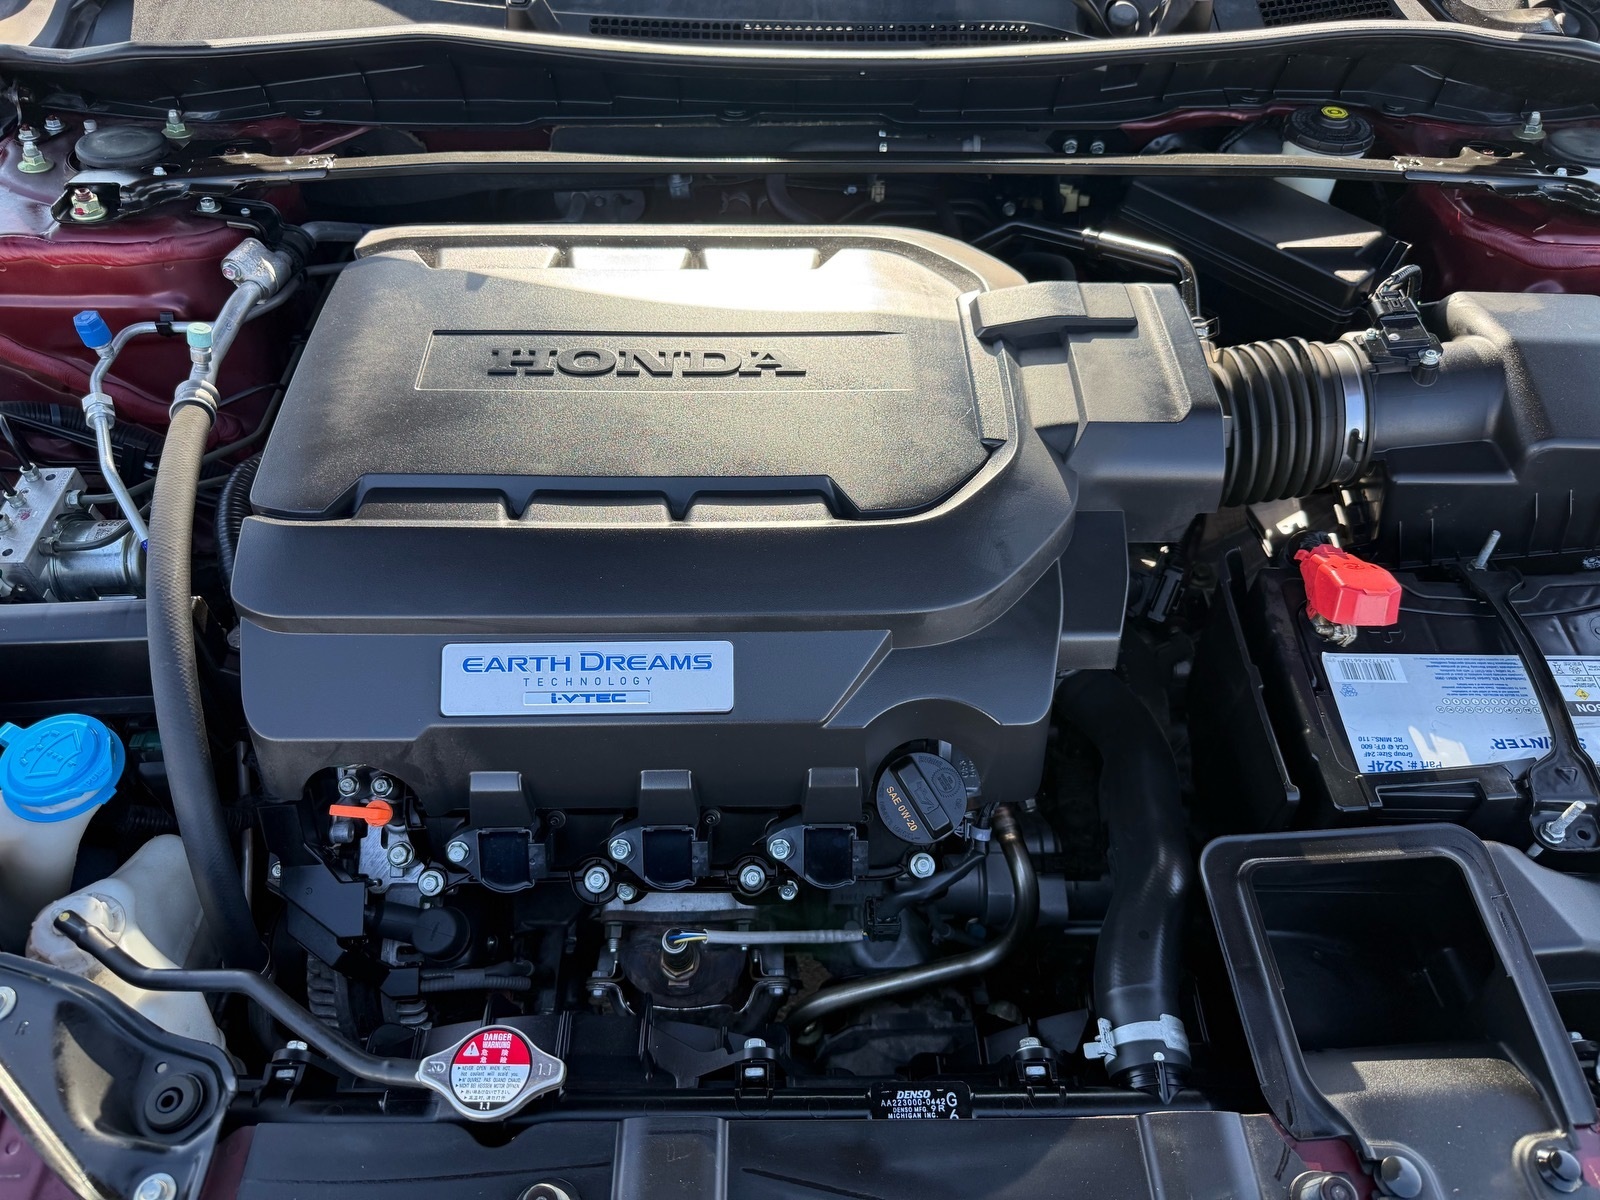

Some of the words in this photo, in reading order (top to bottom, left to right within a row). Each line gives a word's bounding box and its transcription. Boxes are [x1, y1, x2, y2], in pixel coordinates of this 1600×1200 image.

[487, 349, 806, 377] HONDA
[462, 656, 570, 673] EARTH
[580, 652, 713, 672] DREAMS
[523, 677, 653, 687] TECHNOLOGY
[551, 692, 626, 704] i-VTEC
[1367, 760, 1404, 772] S24F
[85, 768, 109, 787] PULL
[886, 786, 902, 806] SAE
[898, 805, 918, 832] 0W-20
[483, 1033, 513, 1041] DANGER
[896, 1090, 931, 1099] DENSO
[946, 1092, 958, 1107] G
[479, 1102, 490, 1110] 1.1
[880, 1098, 946, 1107] AA223000-0442
